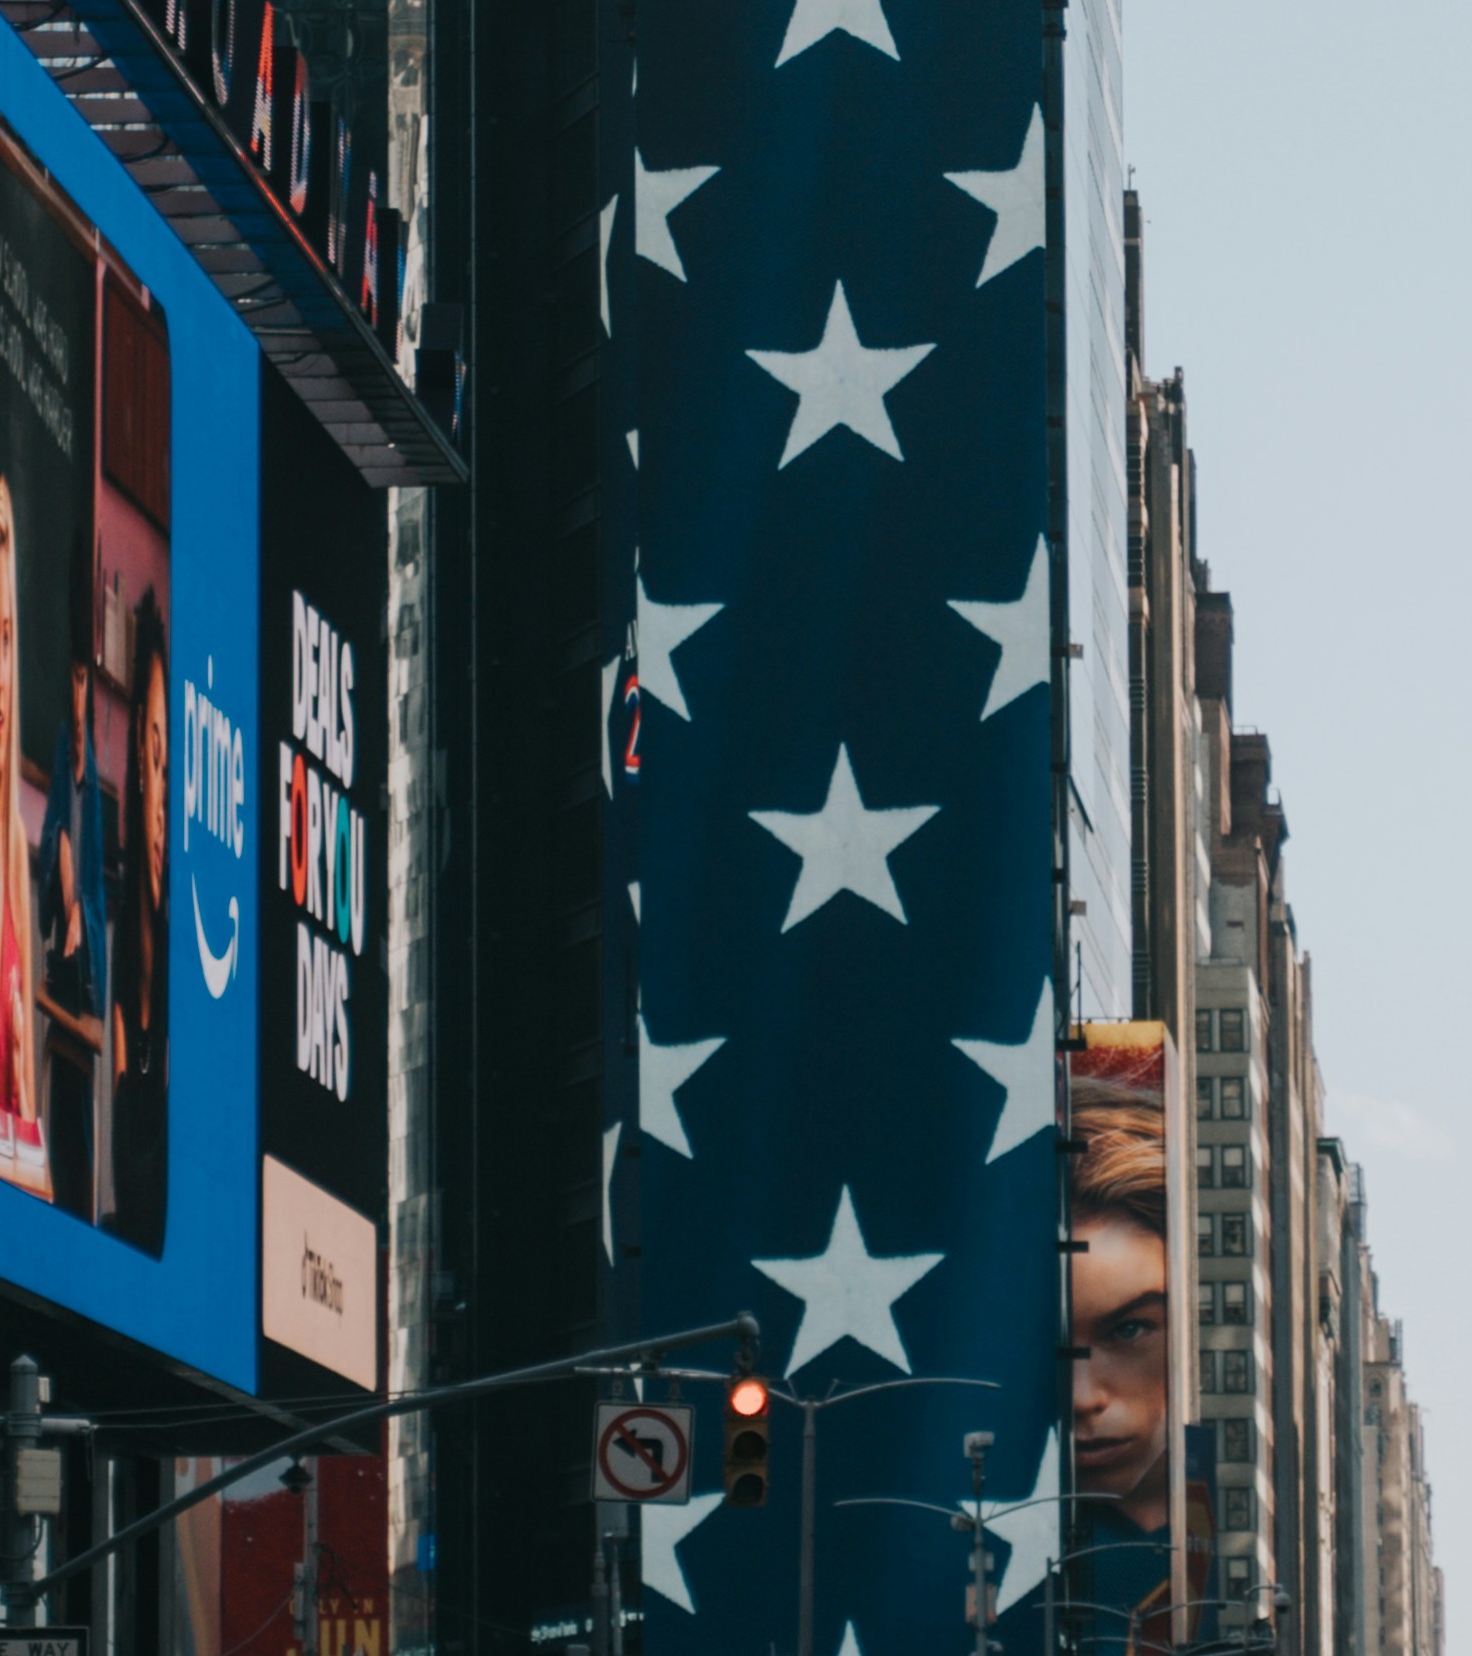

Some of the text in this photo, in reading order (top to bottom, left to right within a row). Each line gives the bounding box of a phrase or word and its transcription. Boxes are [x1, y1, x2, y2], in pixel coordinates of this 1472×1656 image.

[183, 654, 245, 860] prime
[291, 588, 356, 791] DEALS
[296, 922, 350, 1103] DAYS
